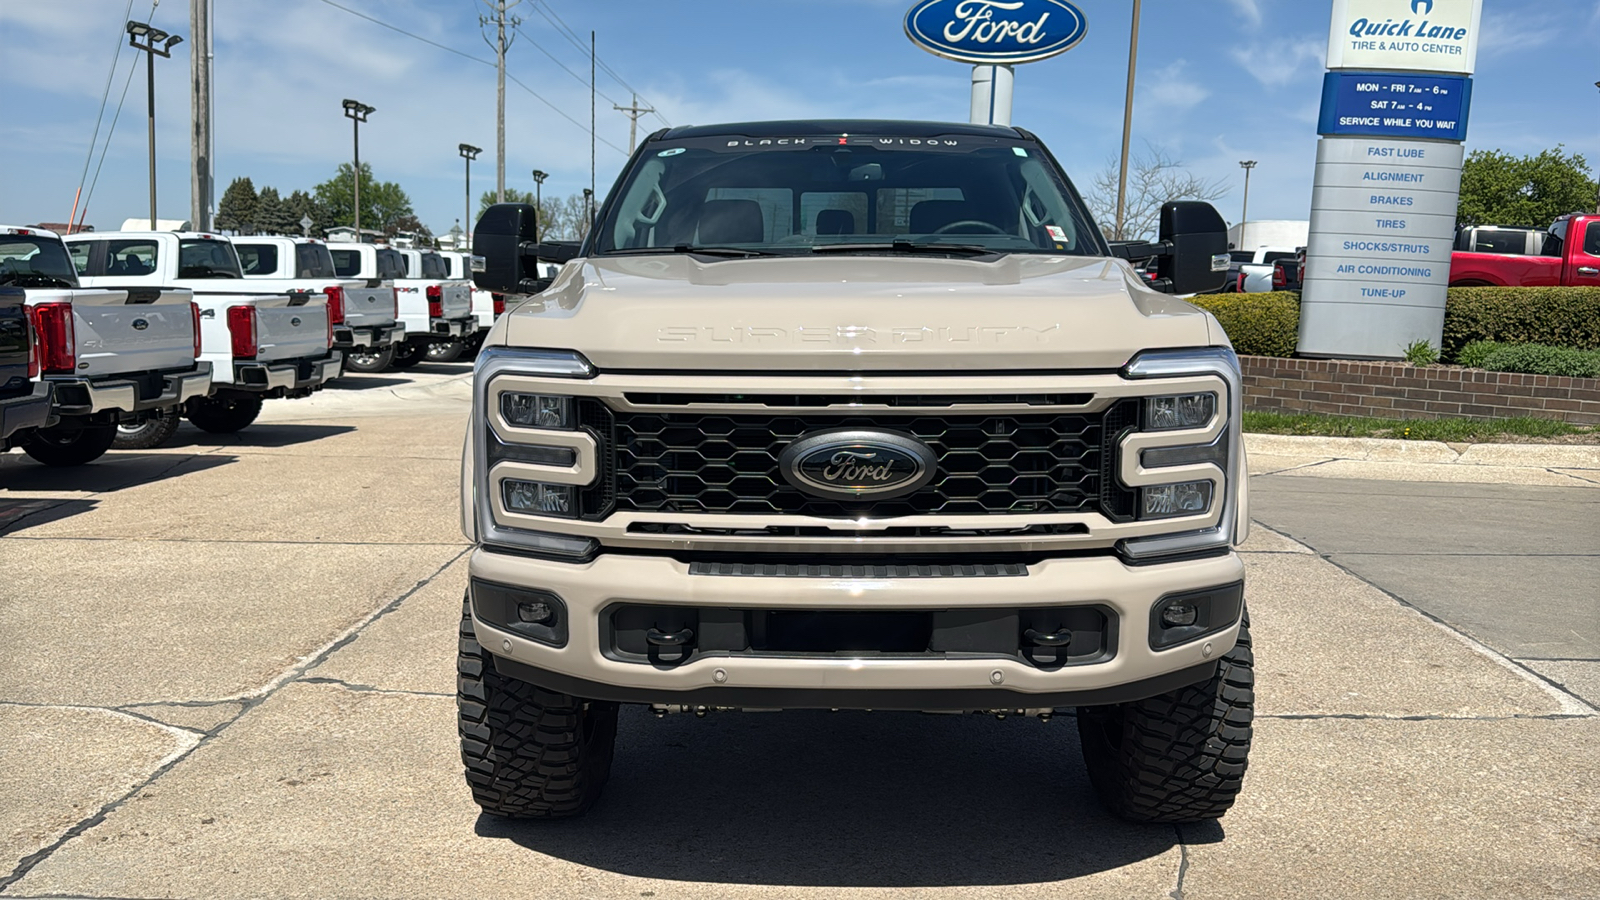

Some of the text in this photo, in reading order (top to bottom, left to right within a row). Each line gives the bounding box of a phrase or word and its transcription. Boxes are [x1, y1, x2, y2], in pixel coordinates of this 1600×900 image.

[943, 0, 1050, 44] Ford
[1349, 18, 1467, 40] Quick Lane
[1351, 41, 1462, 55] TIRE & AUTO CENTER
[1356, 83, 1379, 92] MON
[1390, 83, 1405, 93] FRI
[1370, 100, 1388, 109] SAT
[1339, 117, 1456, 129] SERVICE WHILE YOU WAIT
[727, 138, 958, 147] BLACK WIDOW
[1367, 147, 1425, 158] FAST LUBE
[1362, 172, 1424, 183] ALIGNMENT
[1370, 195, 1413, 206] BRAKES
[1376, 219, 1406, 229] TIRES
[1343, 241, 1430, 254] SHOCKS/STRUTS
[1337, 264, 1432, 278] AIR CONDITIONING
[1360, 288, 1406, 298] TUNE-UP
[656, 323, 1060, 344] SUPER DUTY
[823, 451, 895, 481] Ford
